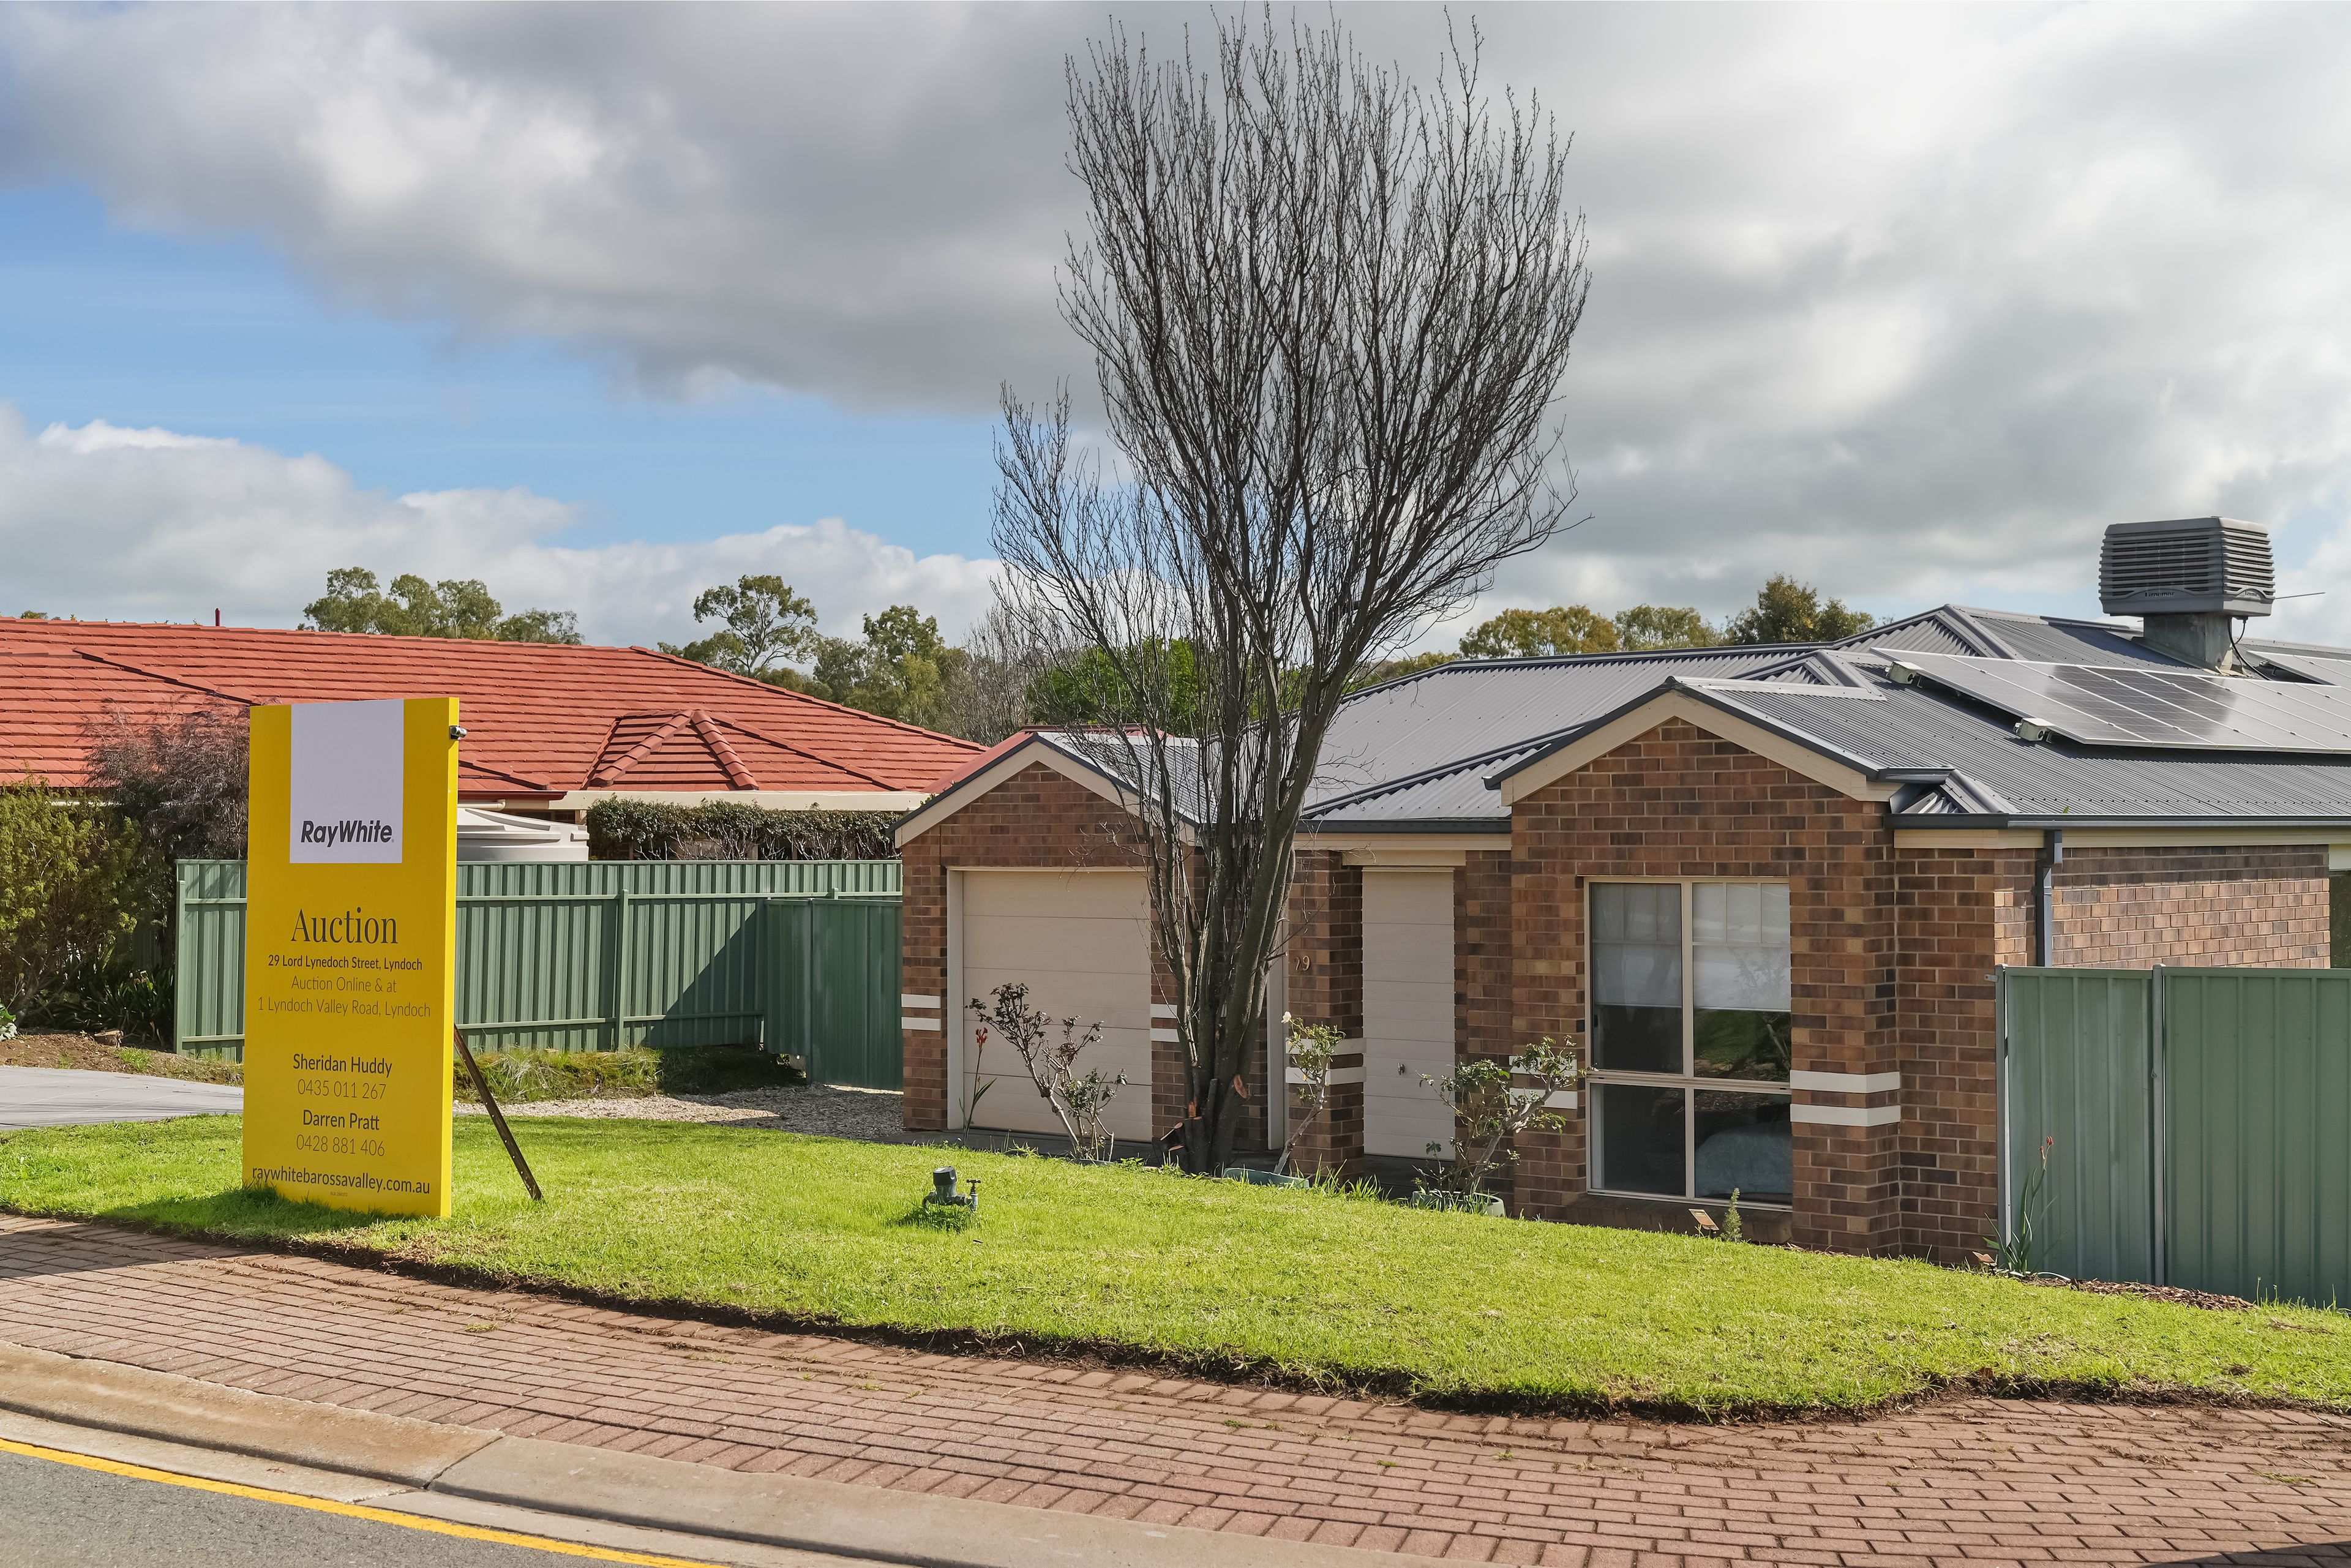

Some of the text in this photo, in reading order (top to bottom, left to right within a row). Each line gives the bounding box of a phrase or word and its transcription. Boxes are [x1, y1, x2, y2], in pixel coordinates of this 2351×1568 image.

[301, 820, 392, 848] RayWhite
[291, 906, 399, 944] Auction
[268, 954, 422, 972] 29 Lord Lynedoch Street, Lyndoch
[291, 975, 397, 993] Auction Online & at
[258, 996, 431, 1019] 1 Lyndoch Valley Road, Lyndoch
[293, 1053, 392, 1078] Sheridan Huddy
[297, 1078, 386, 1100] 0435 011 267
[302, 1109, 380, 1131] Darren Pratt
[296, 1134, 386, 1157] 0428 881 406
[252, 1165, 430, 1195] raywhitebarossavalley.com.au
